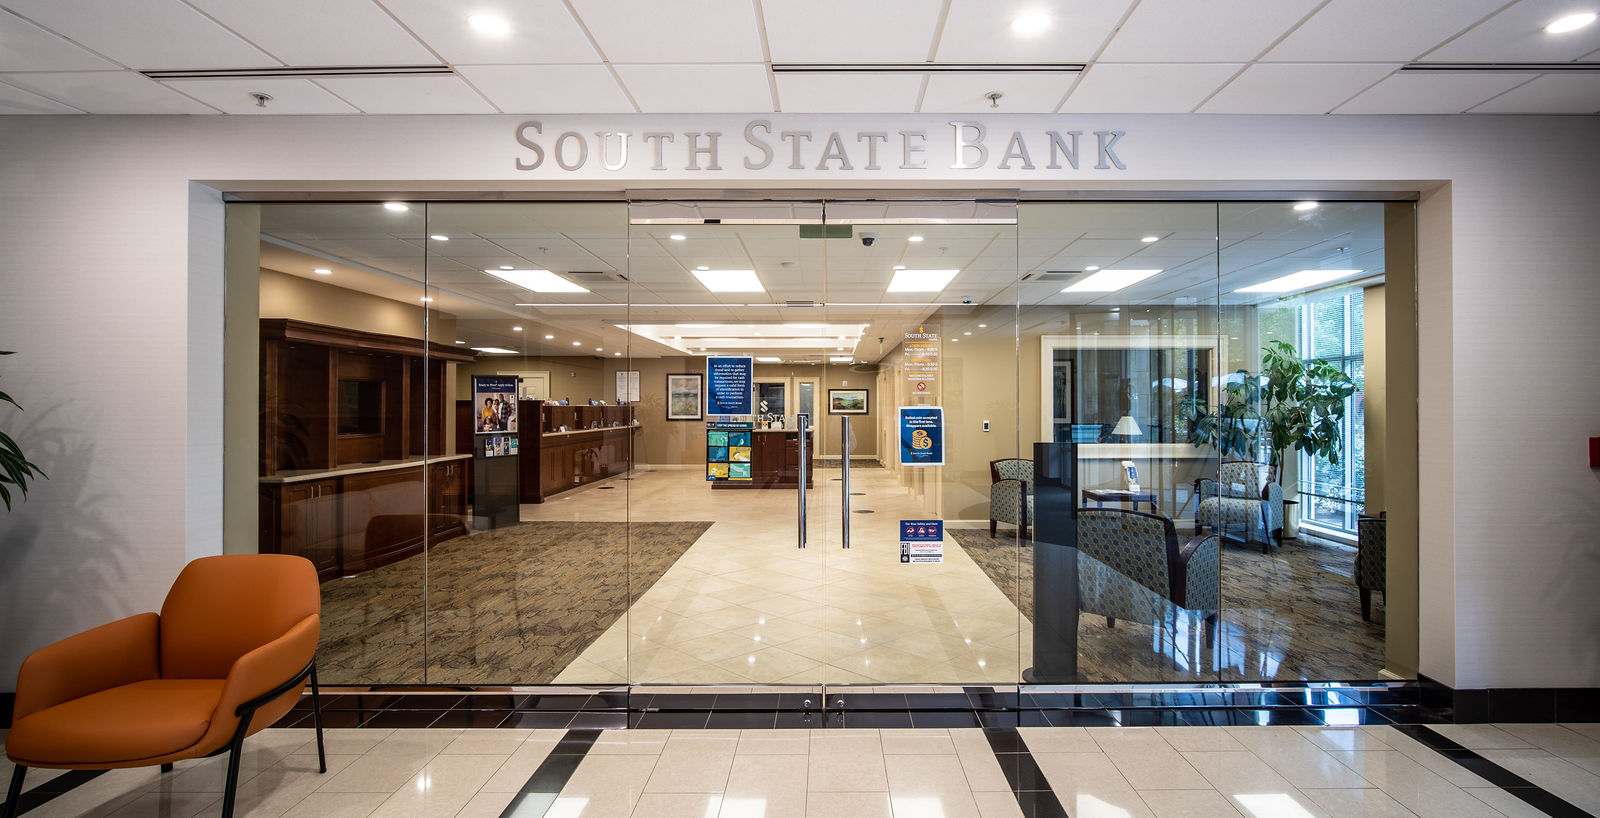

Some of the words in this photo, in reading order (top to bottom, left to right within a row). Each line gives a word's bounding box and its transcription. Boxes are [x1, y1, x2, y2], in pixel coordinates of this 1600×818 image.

[514, 119, 723, 171] SOUTH
[743, 119, 929, 171] STATE
[949, 119, 1128, 171] BANK
